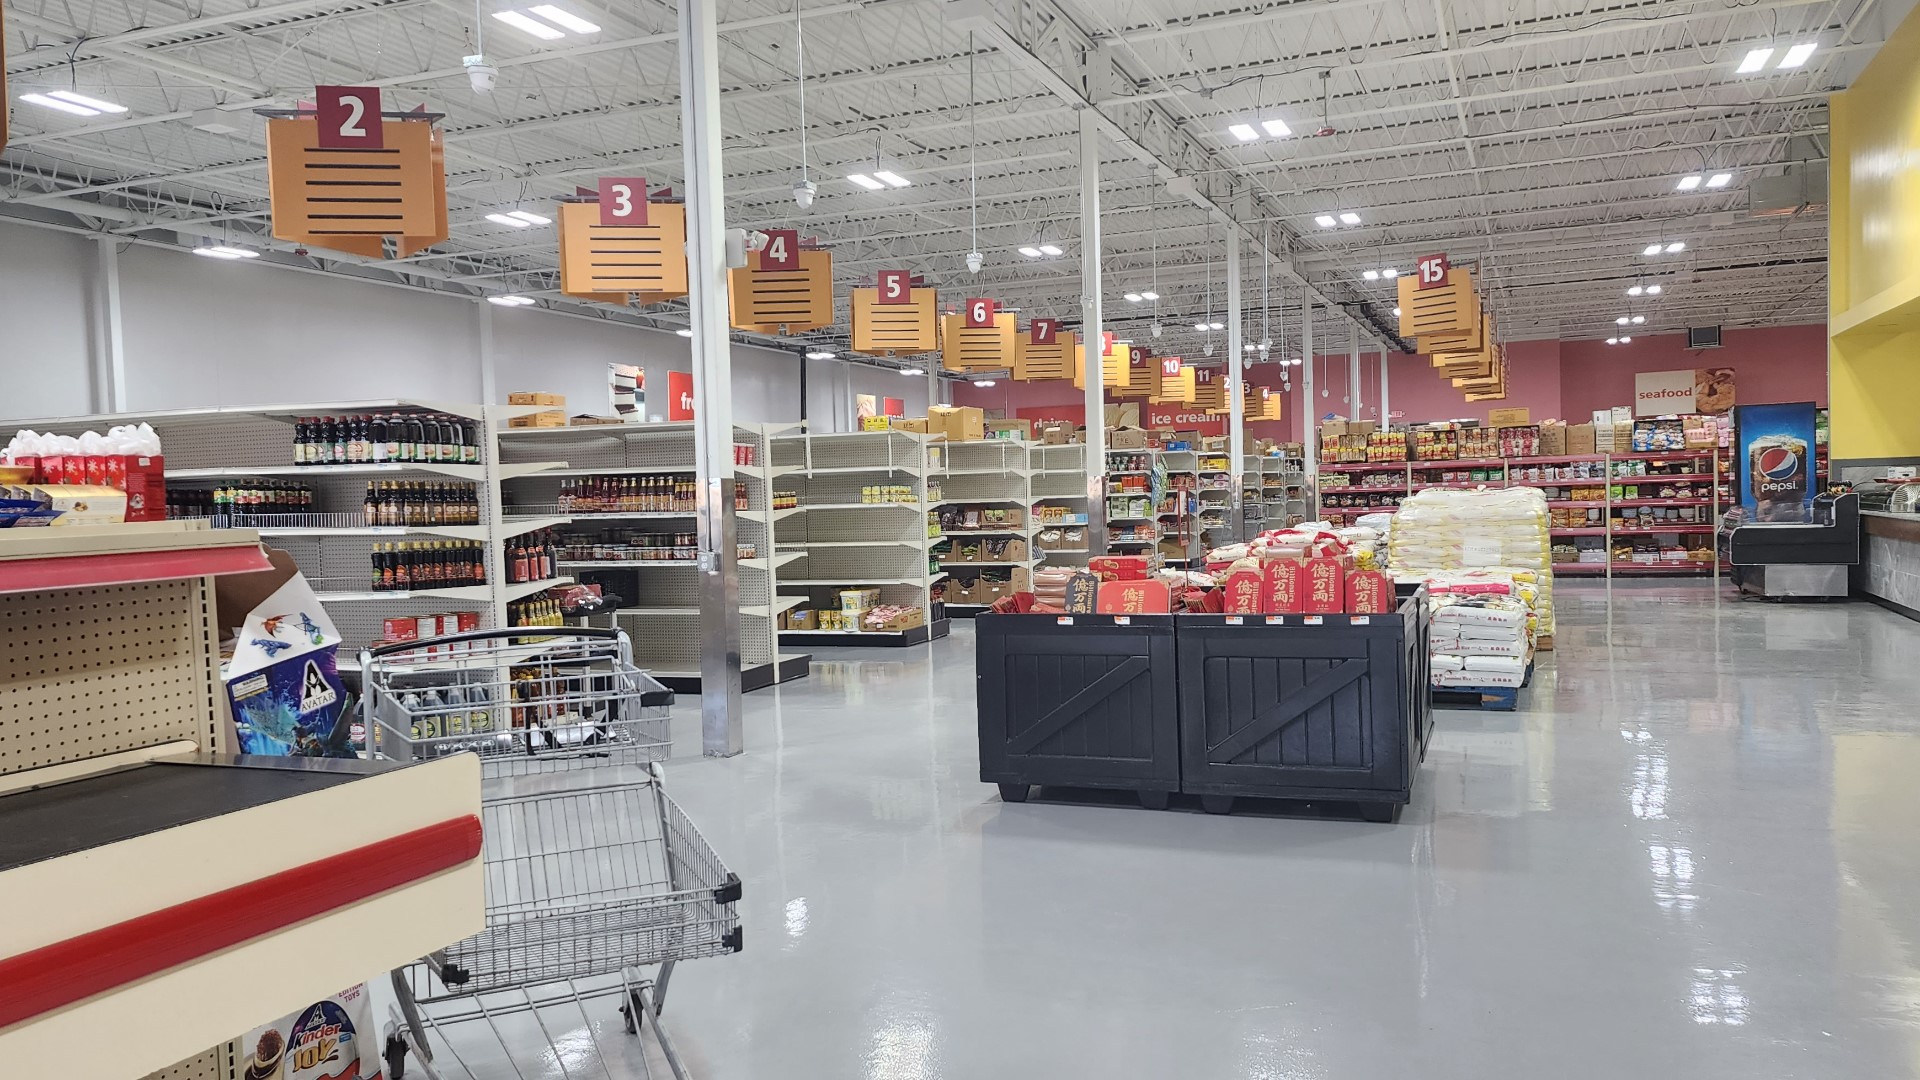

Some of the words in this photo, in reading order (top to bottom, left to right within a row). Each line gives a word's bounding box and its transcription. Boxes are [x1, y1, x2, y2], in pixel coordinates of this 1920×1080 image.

[339, 95, 366, 137] 2
[612, 184, 632, 217] 3
[769, 236, 788, 263] 4
[1420, 258, 1444, 283] 15
[887, 275, 901, 298] 5
[973, 302, 986, 323] 6
[1037, 322, 1048, 340] 7
[1131, 349, 1141, 365] 9
[1163, 360, 1179, 374] 10
[1197, 369, 1210, 382] 11
[1639, 387, 1692, 400] seafood
[1151, 412, 1172, 425] ice
[1175, 412, 1221, 424] cream
[1761, 480, 1796, 492] pepsi
[301, 691, 337, 713] AVATAR
[344, 989, 361, 1003] TOYS
[293, 1023, 342, 1050] Kinder
[292, 1038, 338, 1074] JOY
